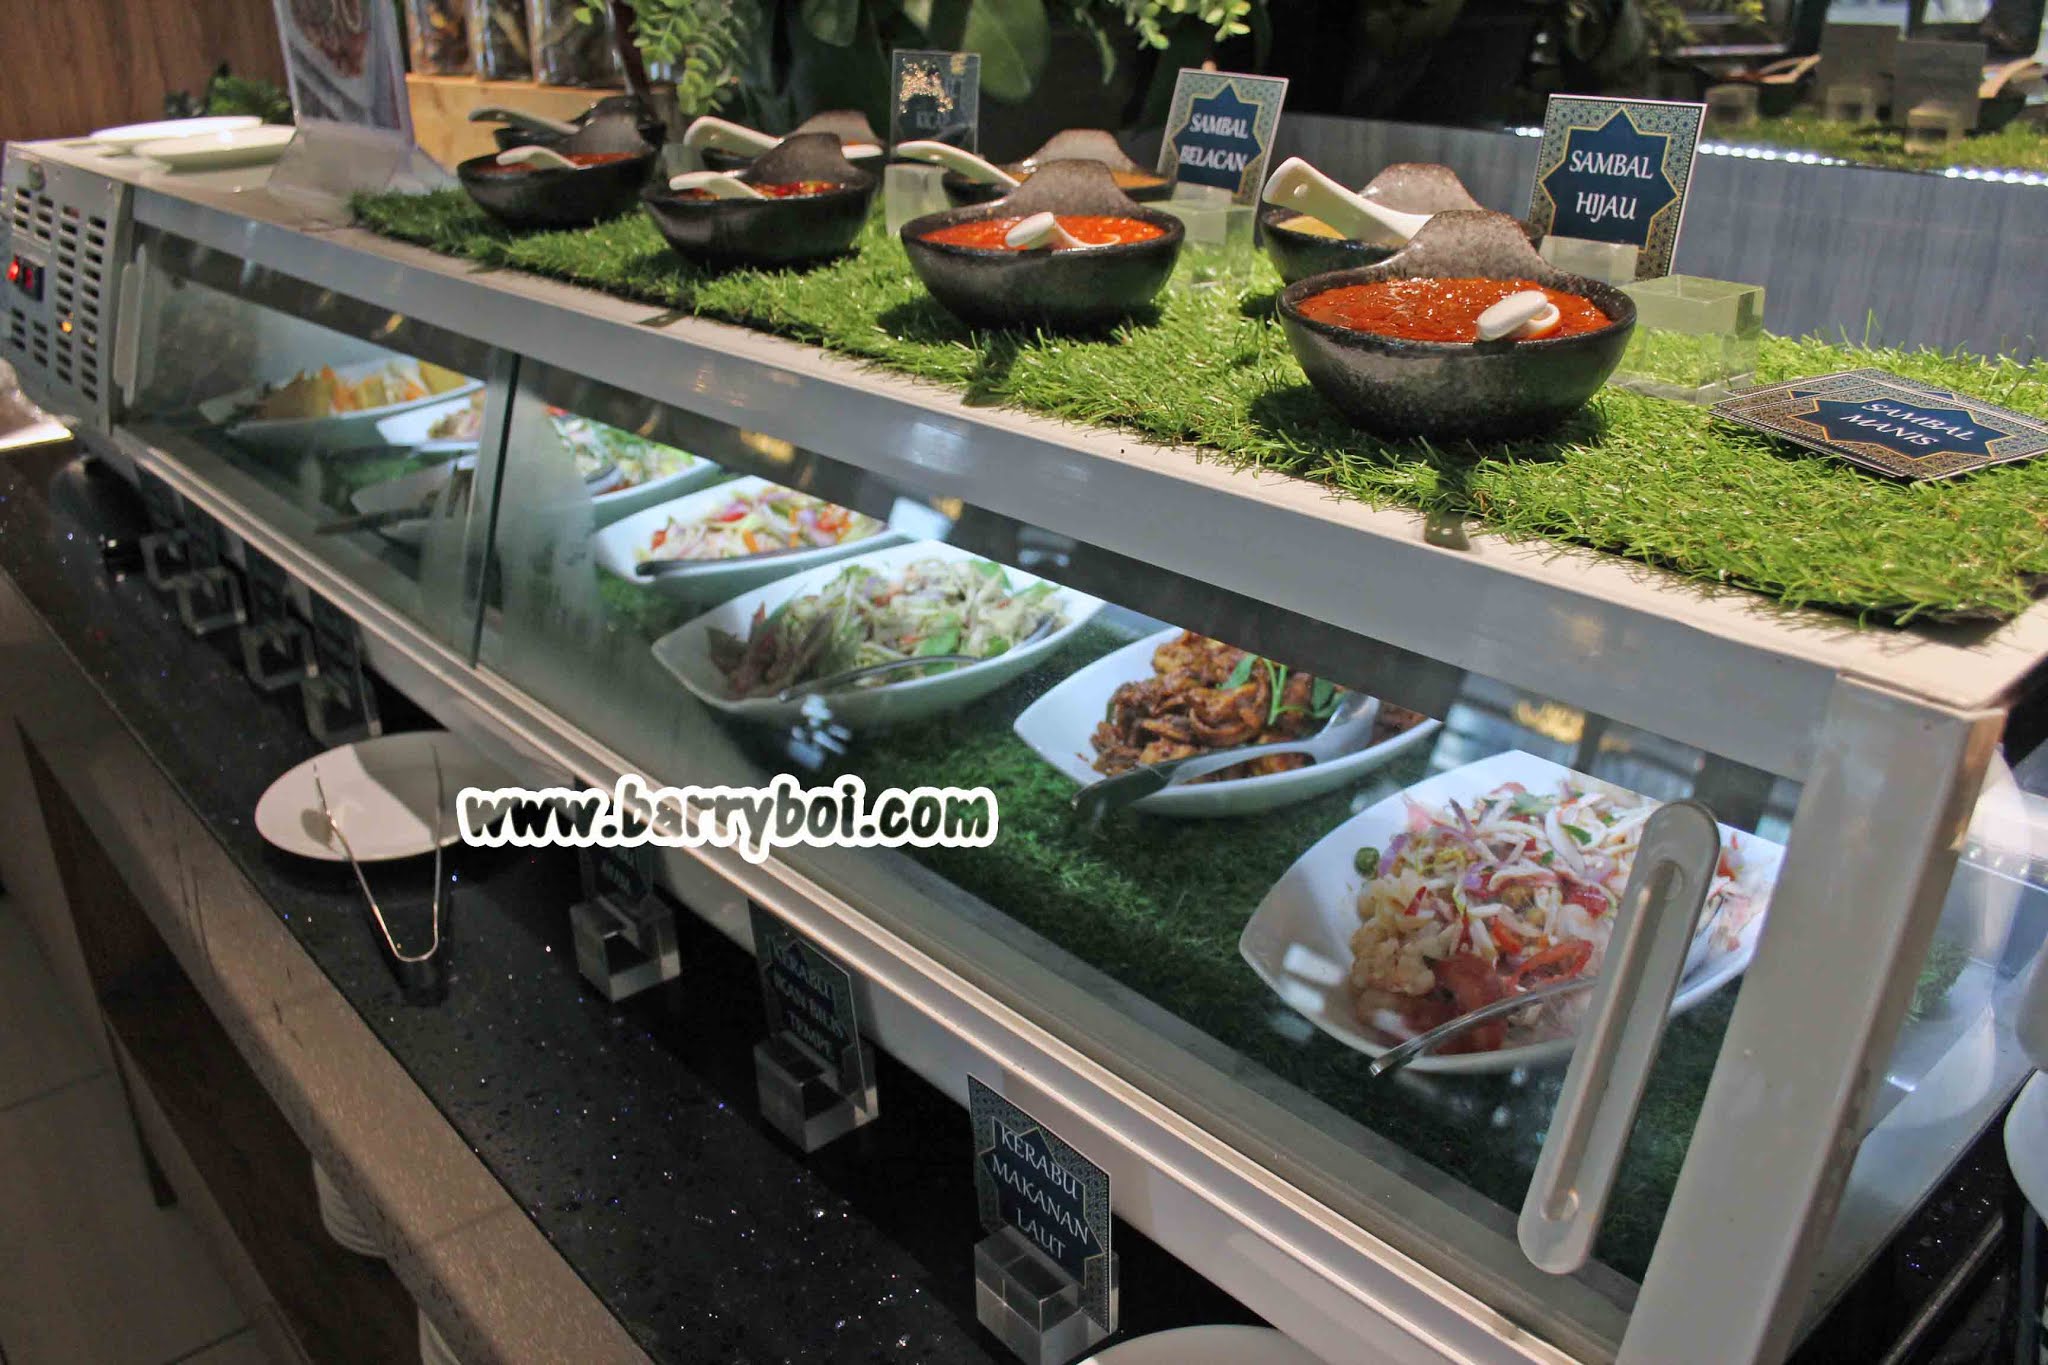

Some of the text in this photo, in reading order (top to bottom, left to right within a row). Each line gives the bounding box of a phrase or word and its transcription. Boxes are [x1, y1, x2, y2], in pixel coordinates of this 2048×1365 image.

[1189, 112, 1249, 139] SAMBAL
[1179, 145, 1249, 172] BELACAN
[1569, 150, 1654, 180] SAMBAL
[1576, 191, 1638, 223] HIJAU
[1840, 414, 1940, 446] MANIS
[1861, 403, 1977, 441] SAMBAL
[1001, 1125, 1079, 1200] KERABU
[992, 1154, 1089, 1246] MAKANAN
[1017, 1207, 1066, 1260] LAUT
